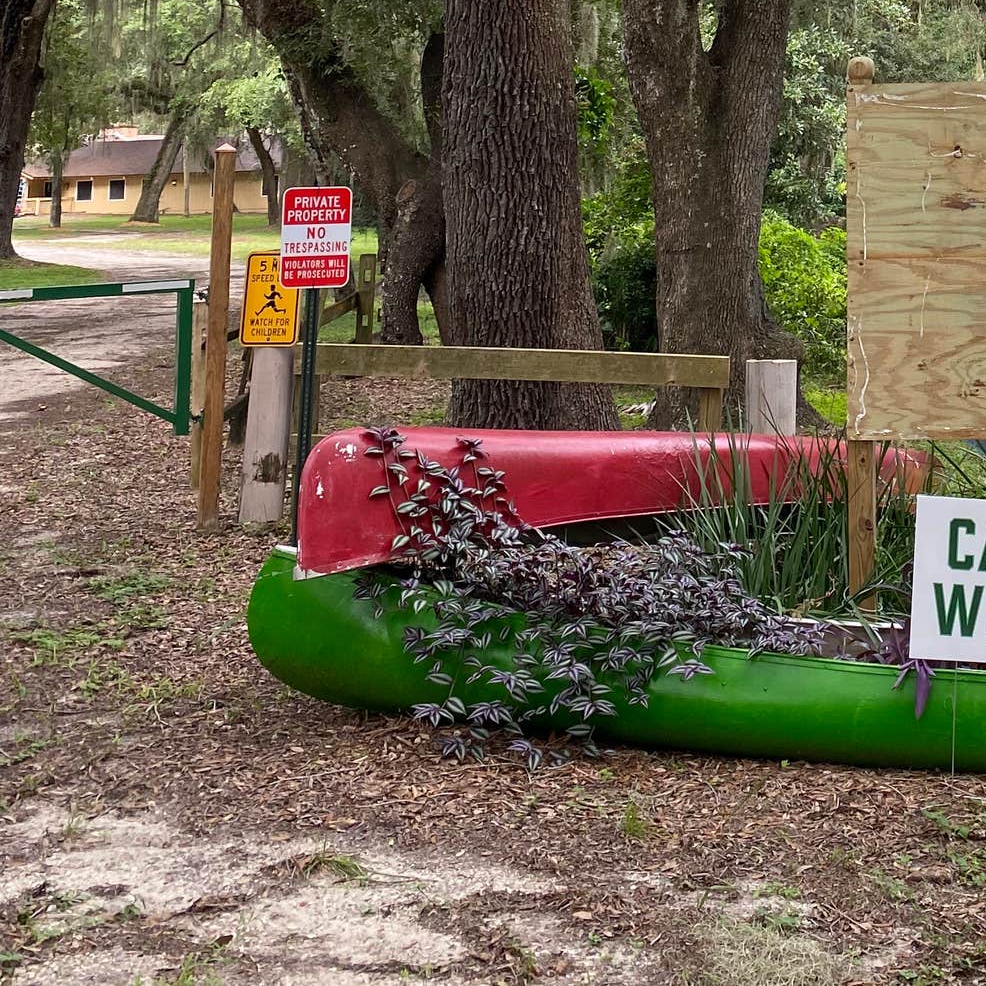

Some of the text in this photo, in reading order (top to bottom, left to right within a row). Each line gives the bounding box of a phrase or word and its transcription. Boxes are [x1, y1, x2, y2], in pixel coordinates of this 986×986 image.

[294, 196, 341, 208] PRIVATE
[287, 209, 346, 222] PROPERTY
[306, 227, 326, 239] NO
[284, 241, 347, 253] TRESPASSING
[260, 260, 267, 272] 5
[284, 260, 325, 269] VIOLATORS
[328, 259, 345, 268] WILL
[252, 274, 274, 282] SPEED
[284, 270, 293, 279] BE
[297, 270, 345, 279] PROSECUTED
[250, 318, 290, 326] WATCH FOR
[251, 328, 287, 336] CHILDREN
